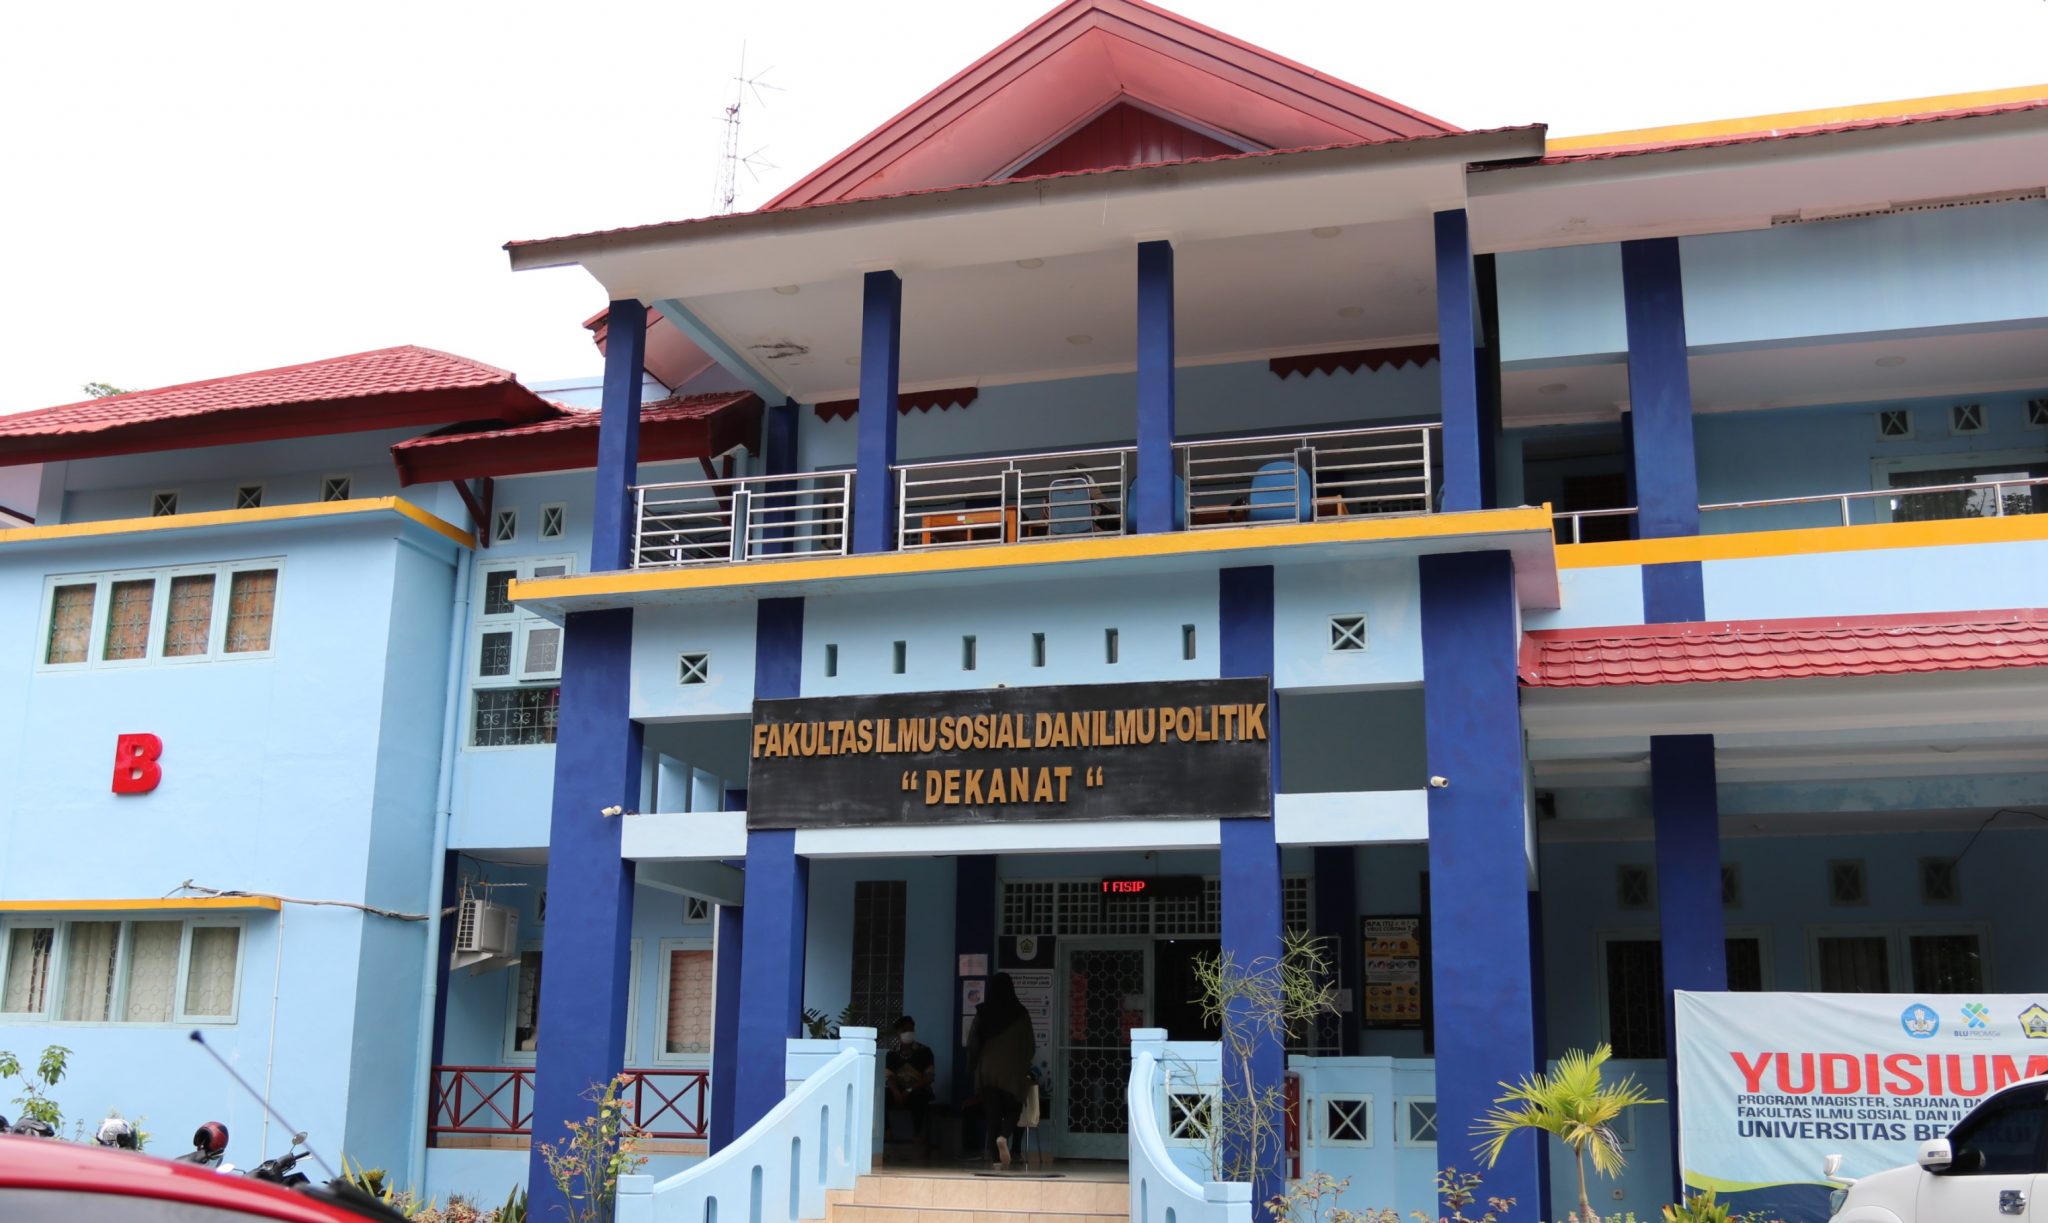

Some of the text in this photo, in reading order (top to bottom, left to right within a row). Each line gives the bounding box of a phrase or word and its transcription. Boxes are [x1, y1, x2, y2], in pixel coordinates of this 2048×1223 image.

[753, 703, 1267, 758] FAKULTAS ILMU SOSIAL DAN ILMU POLITIK
[111, 732, 163, 795] B
[1112, 881, 1145, 892] FISIP
[1729, 1052, 2048, 1097] YUDISIUM
[1737, 1095, 1807, 1106] PROGRAM
[1893, 1097, 1960, 1108] SARJANA
[1737, 1107, 1812, 1118] FAKULTAS
[1815, 1108, 1853, 1119] ILMU
[1857, 1109, 1912, 1120] SOSIAL
[1915, 1110, 1948, 1121] DAN
[1737, 1120, 1906, 1141] UNIVERSITAS
